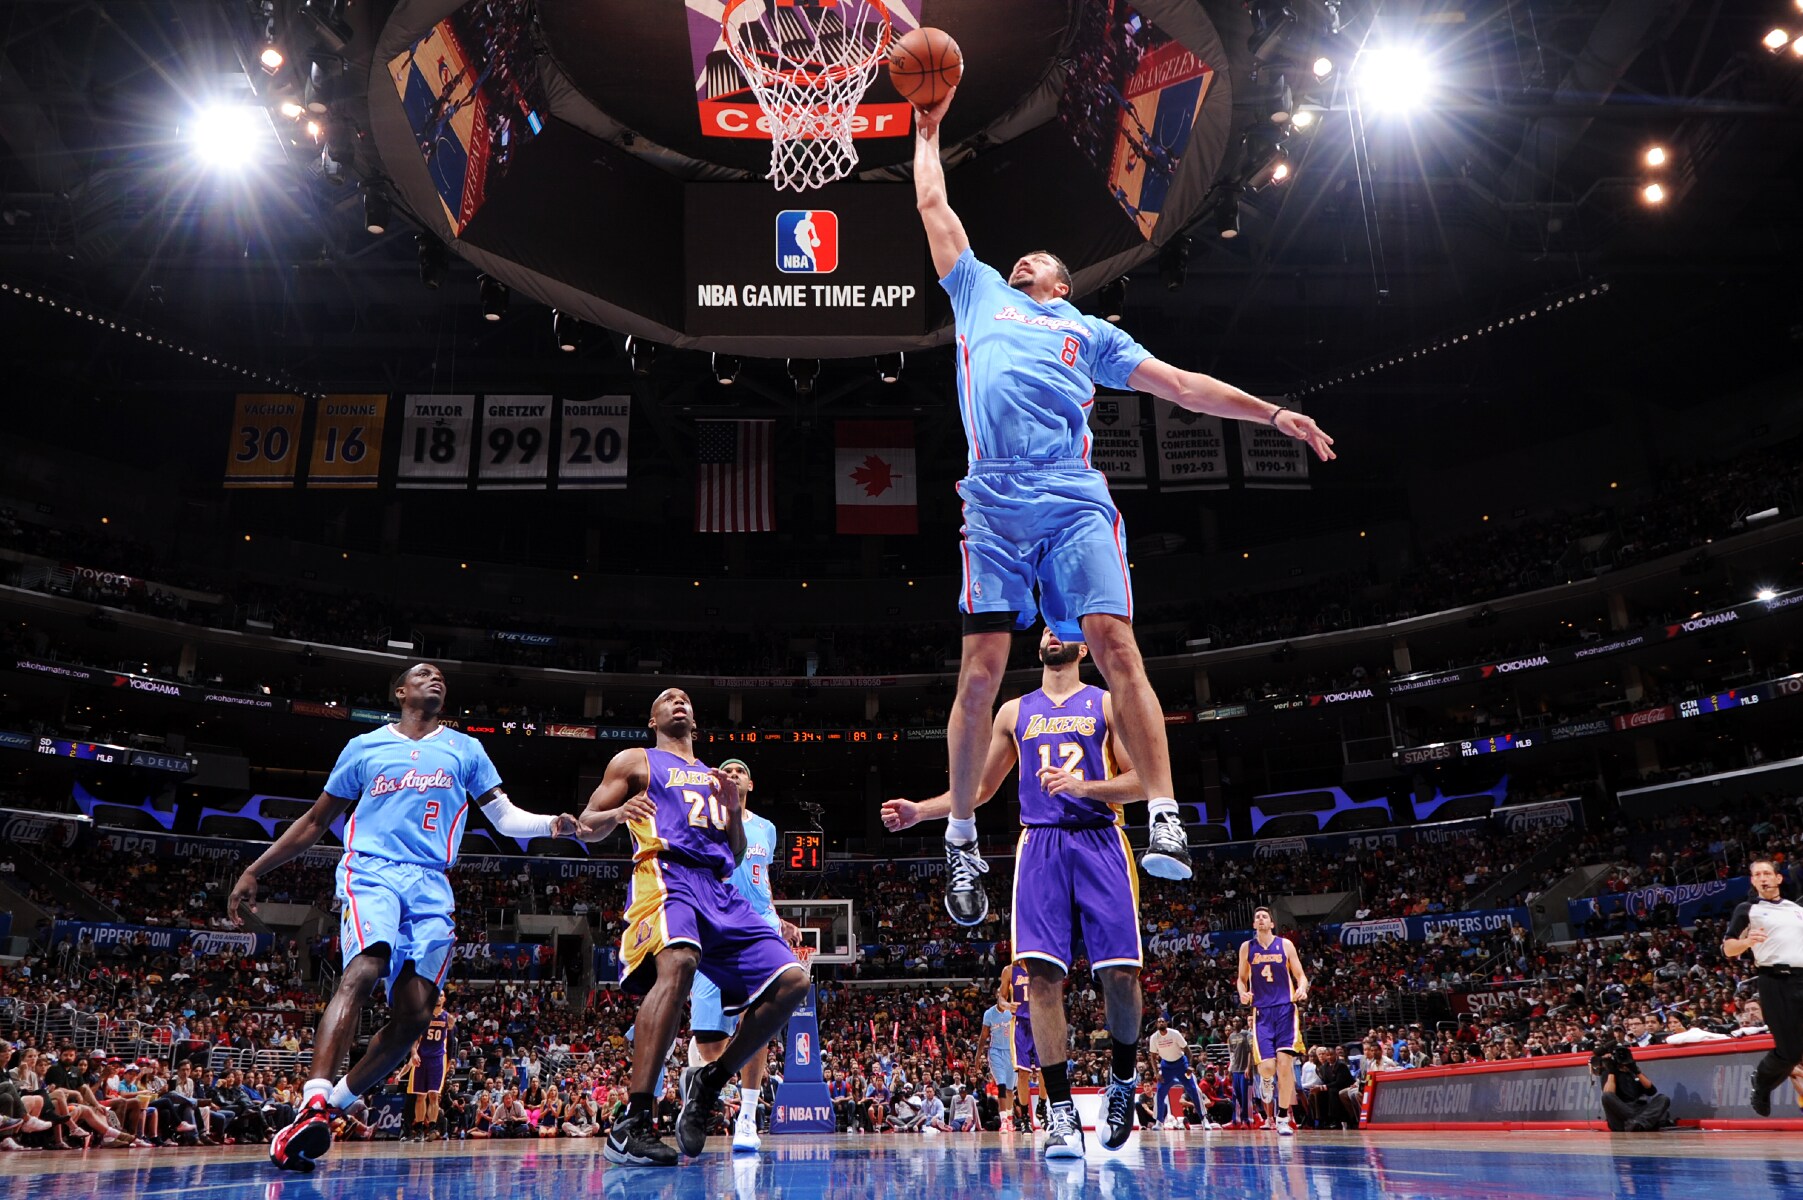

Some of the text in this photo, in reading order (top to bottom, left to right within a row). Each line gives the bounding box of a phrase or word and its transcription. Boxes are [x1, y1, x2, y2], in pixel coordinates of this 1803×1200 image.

[1128, 51, 1195, 95] LOS ANGELES
[784, 255, 808, 268] NBA
[698, 284, 915, 307] NBA GAME TIME APP
[1060, 335, 1080, 368] 8
[244, 405, 296, 416] VACHON
[326, 404, 376, 416] DIONNE
[416, 405, 462, 417] TAYLOR
[488, 405, 546, 417] GRETZKY
[564, 405, 628, 417] ROBITAILLE
[1166, 429, 1213, 438] CAMPBELL
[235, 425, 291, 463] 30
[324, 425, 367, 464] 16
[413, 427, 456, 464] 18
[488, 427, 542, 464] 99
[567, 427, 622, 464] 20
[1094, 439, 1139, 448] NFERENCE
[1161, 439, 1221, 449] CONFERENCE
[1253, 439, 1292, 448] DIVISION
[1092, 449, 1137, 458] HAMPIONS
[1165, 450, 1218, 460] CHAMPIONS
[1248, 449, 1300, 458] CHAMPIONS
[1094, 462, 1131, 472] 2011-12
[1171, 462, 1214, 473] 1992-93
[1256, 461, 1296, 472] 1990-91
[75, 566, 132, 588] TOYOTA
[1681, 610, 1740, 632] YOKOHAMA
[520, 634, 553, 643] LIGHT
[1575, 635, 1644, 659] yokohamatire.com
[16, 660, 90, 680] yokohamatire.com
[1495, 655, 1550, 674] YOKOHAMA
[129, 678, 181, 696] YOKOHAMA
[1388, 674, 1460, 695] yokohamatire.com
[204, 693, 272, 708] yokohamatire.com
[1323, 688, 1374, 704] YOKOHAMA
[1680, 700, 1697, 710] CIN
[1711, 695, 1717, 704] 2
[1682, 708, 1700, 718] NYM
[1740, 695, 1759, 706] MLB
[502, 721, 536, 730] LAC LAL
[1022, 714, 1096, 741] LAKERS
[40, 737, 52, 746] SD
[612, 730, 648, 739] DELTA
[853, 731, 866, 741] 89
[38, 745, 56, 755] MIA
[96, 753, 113, 763] MLB
[1405, 746, 1451, 764] STAPLES
[1462, 748, 1479, 757] MIA
[1515, 739, 1532, 749] MLB
[148, 756, 189, 770] DELTA
[1038, 742, 1084, 781] 12
[370, 768, 453, 797] Los Angeles
[422, 800, 440, 832] 2
[682, 789, 727, 830] 20
[796, 836, 819, 847] 3:34
[746, 844, 766, 860] geles
[791, 848, 817, 868] 21
[561, 864, 619, 879] CLIPPERS
[752, 864, 761, 885] 9
[1375, 923, 1400, 931] ANGELES
[1261, 964, 1274, 982] 4
[427, 1028, 441, 1041] 50
[1382, 1083, 1472, 1114] NBATICKETS.COM
[379, 1105, 403, 1129] Los
[790, 1107, 830, 1121] NBA TV
